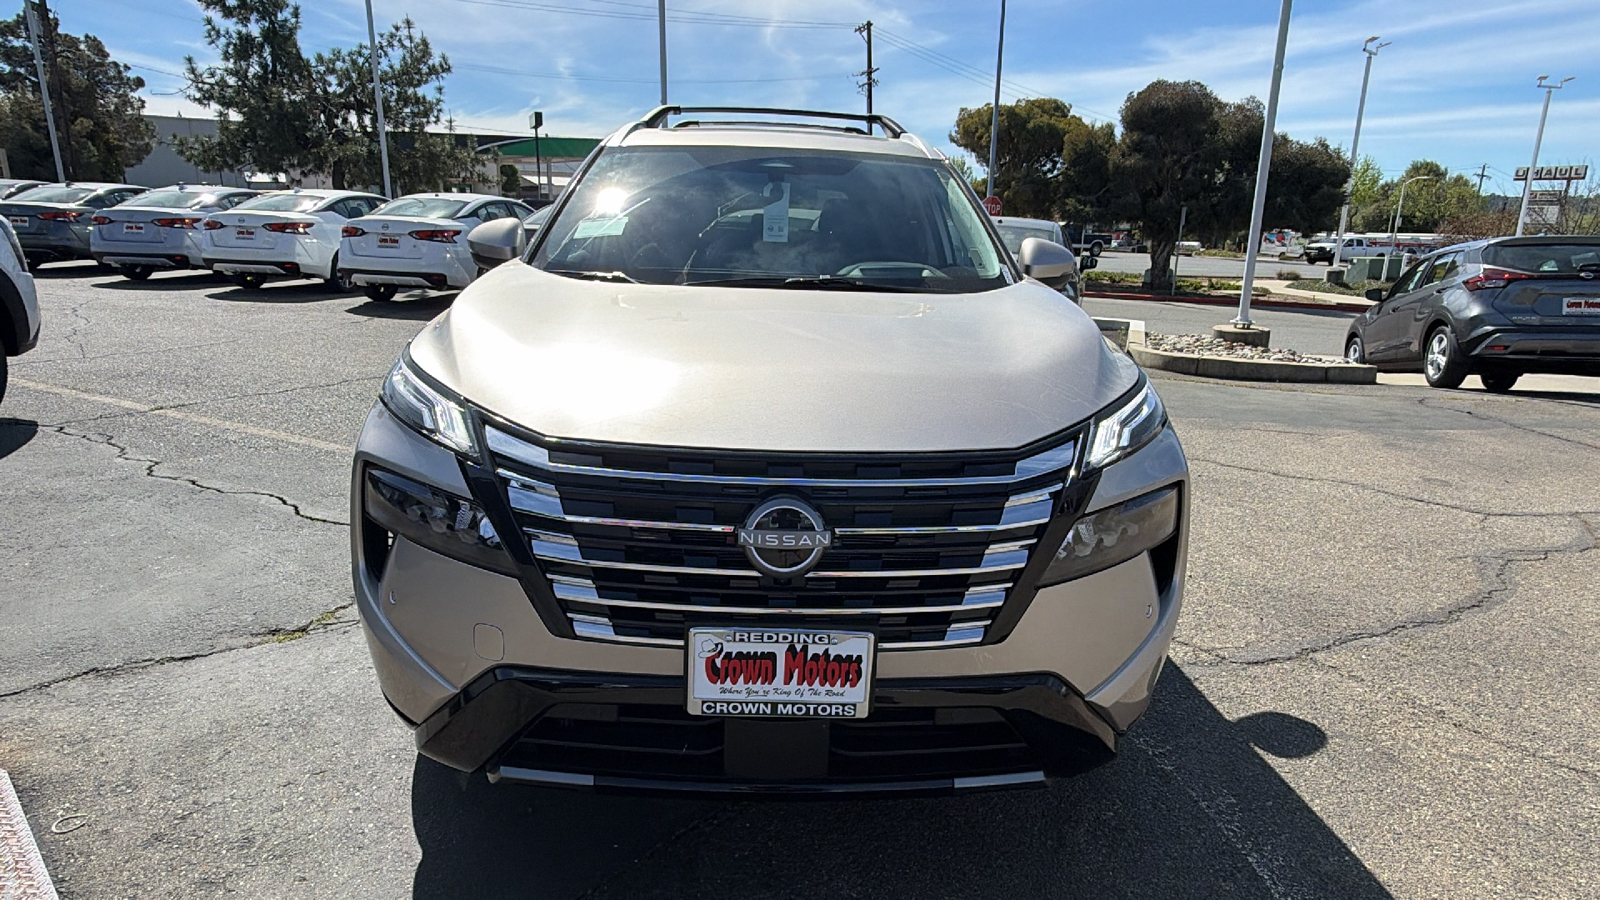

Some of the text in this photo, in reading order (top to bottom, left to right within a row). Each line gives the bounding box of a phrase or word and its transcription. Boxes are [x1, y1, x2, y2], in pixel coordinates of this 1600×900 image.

[740, 531, 829, 546] NISSAN
[735, 632, 829, 644] REDDING
[704, 643, 863, 688] Crown Motors
[719, 686, 846, 698] Where You're King Of The Road
[702, 702, 855, 716] CROWN MOTORS
